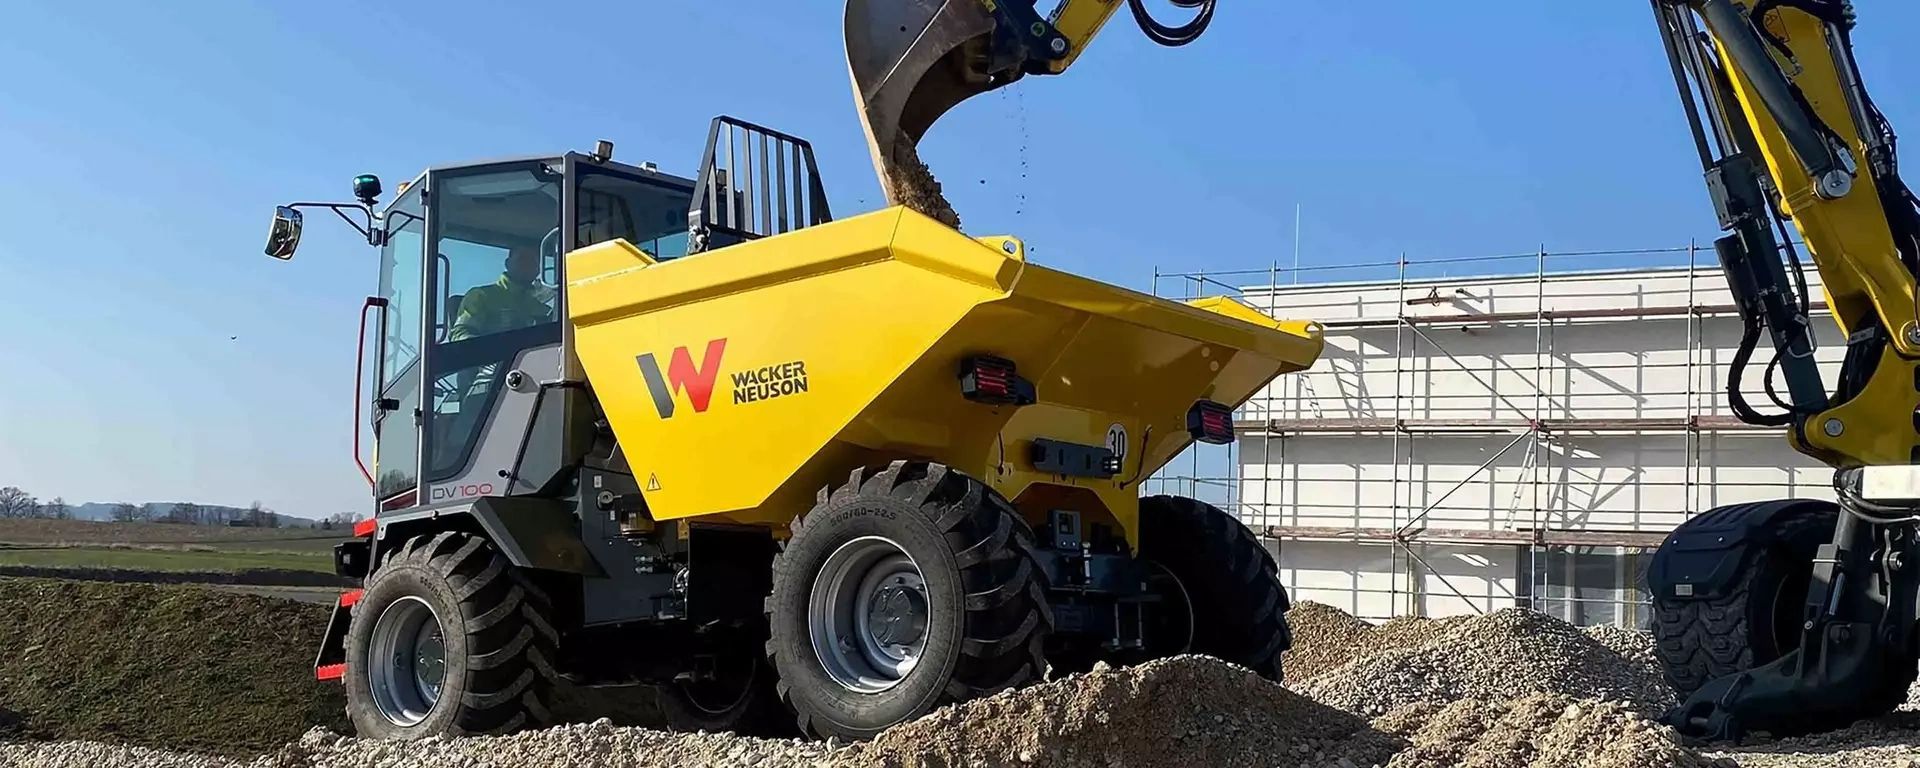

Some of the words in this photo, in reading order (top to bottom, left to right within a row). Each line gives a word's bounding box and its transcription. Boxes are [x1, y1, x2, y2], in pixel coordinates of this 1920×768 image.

[731, 361, 806, 388] WACKER
[733, 377, 808, 404] NEUSON
[1109, 429, 1125, 458] 30
[433, 486, 456, 499] DV
[460, 483, 493, 496] 100
